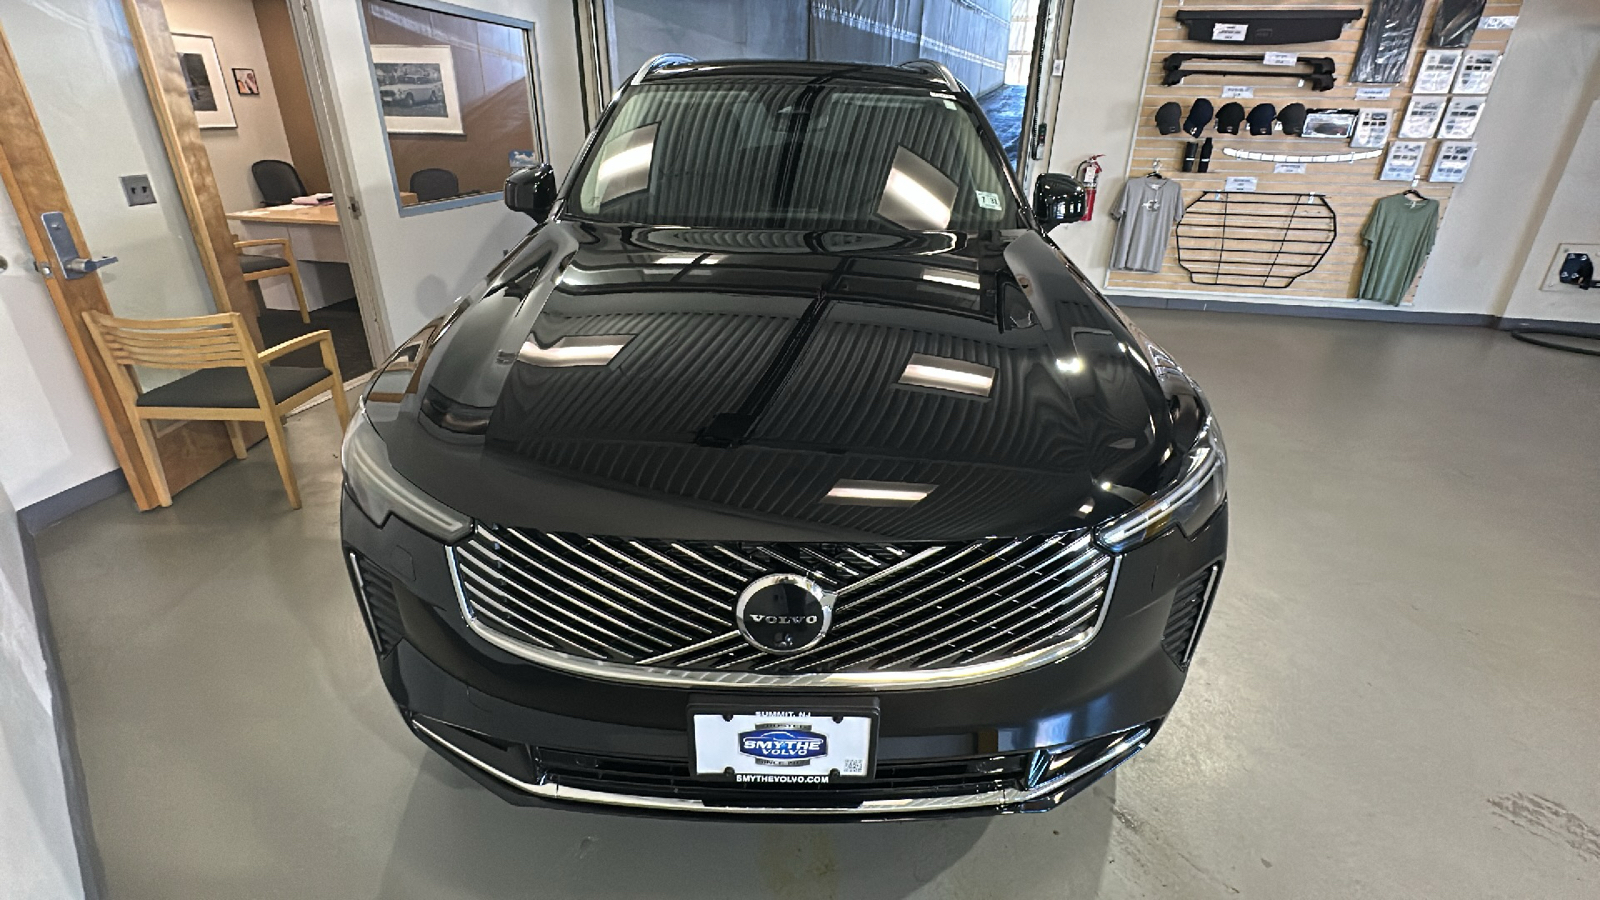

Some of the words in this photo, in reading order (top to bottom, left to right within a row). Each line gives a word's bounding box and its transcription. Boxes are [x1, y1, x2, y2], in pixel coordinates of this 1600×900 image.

[749, 614, 818, 624] VOLVO
[744, 741, 821, 750] SMYTHE
[736, 774, 829, 784] SMYTHEVOLVO.COM
